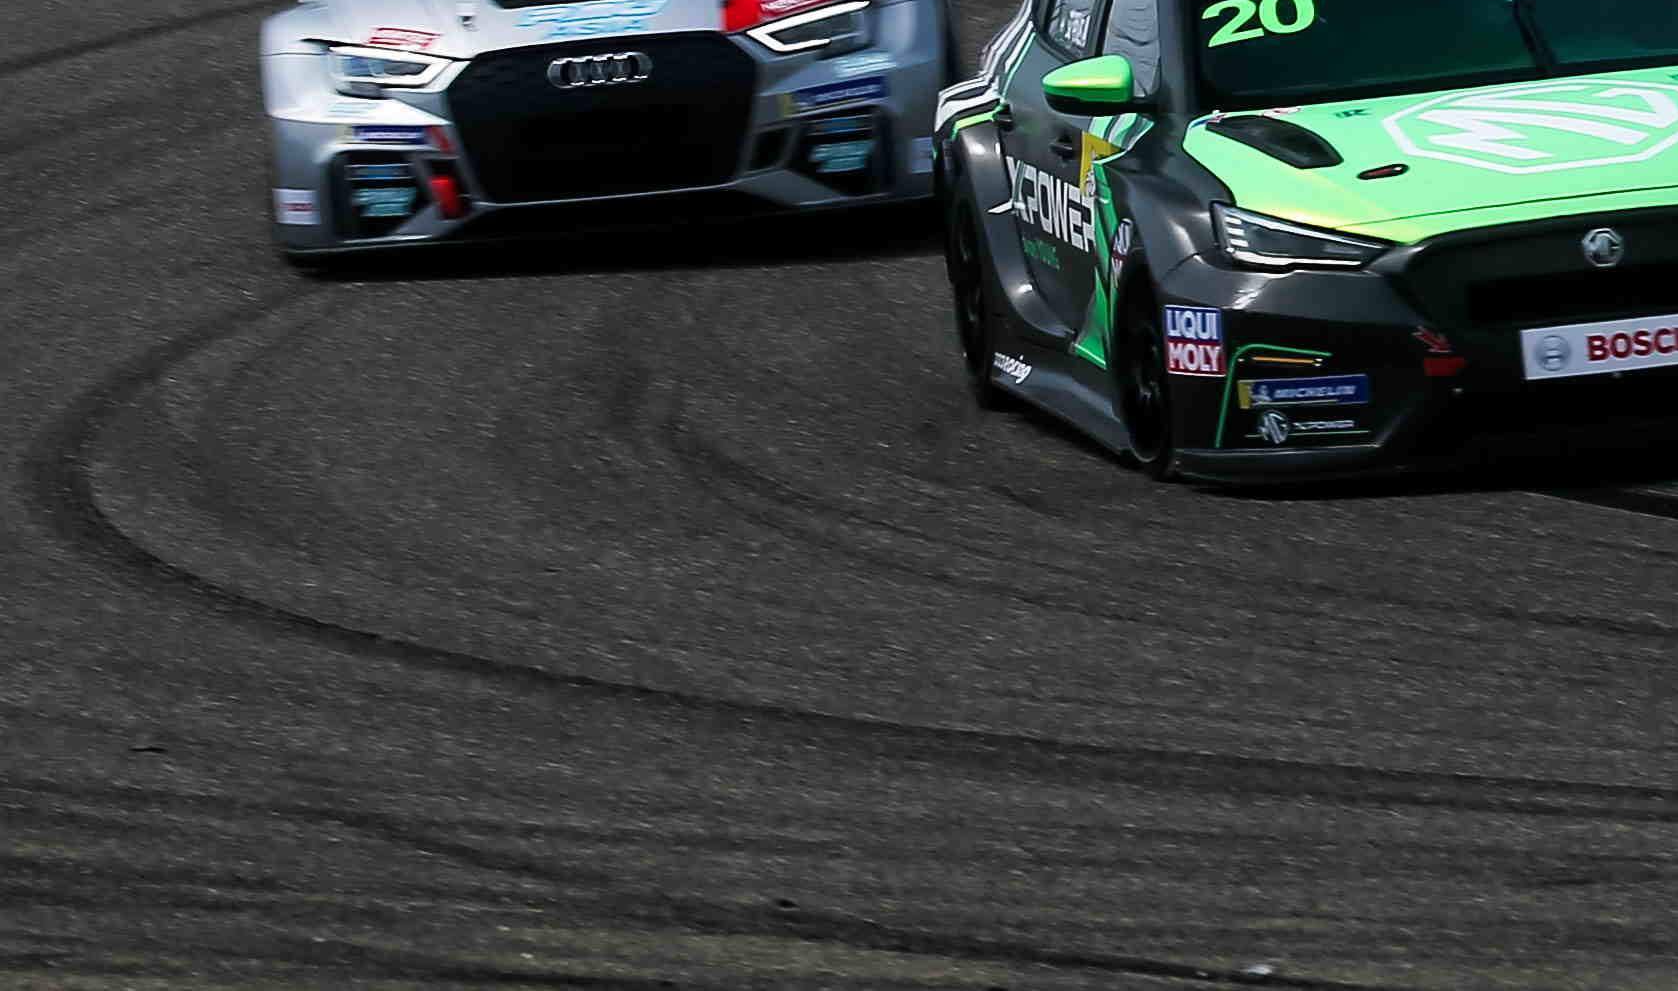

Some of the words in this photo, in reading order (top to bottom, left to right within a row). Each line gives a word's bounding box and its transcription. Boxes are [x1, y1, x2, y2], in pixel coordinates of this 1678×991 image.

[988, 155, 1097, 253] XPOWER
[1166, 309, 1218, 340] LIQUI
[1167, 342, 1221, 372] MOLY
[1274, 385, 1357, 398] MICHELIN
